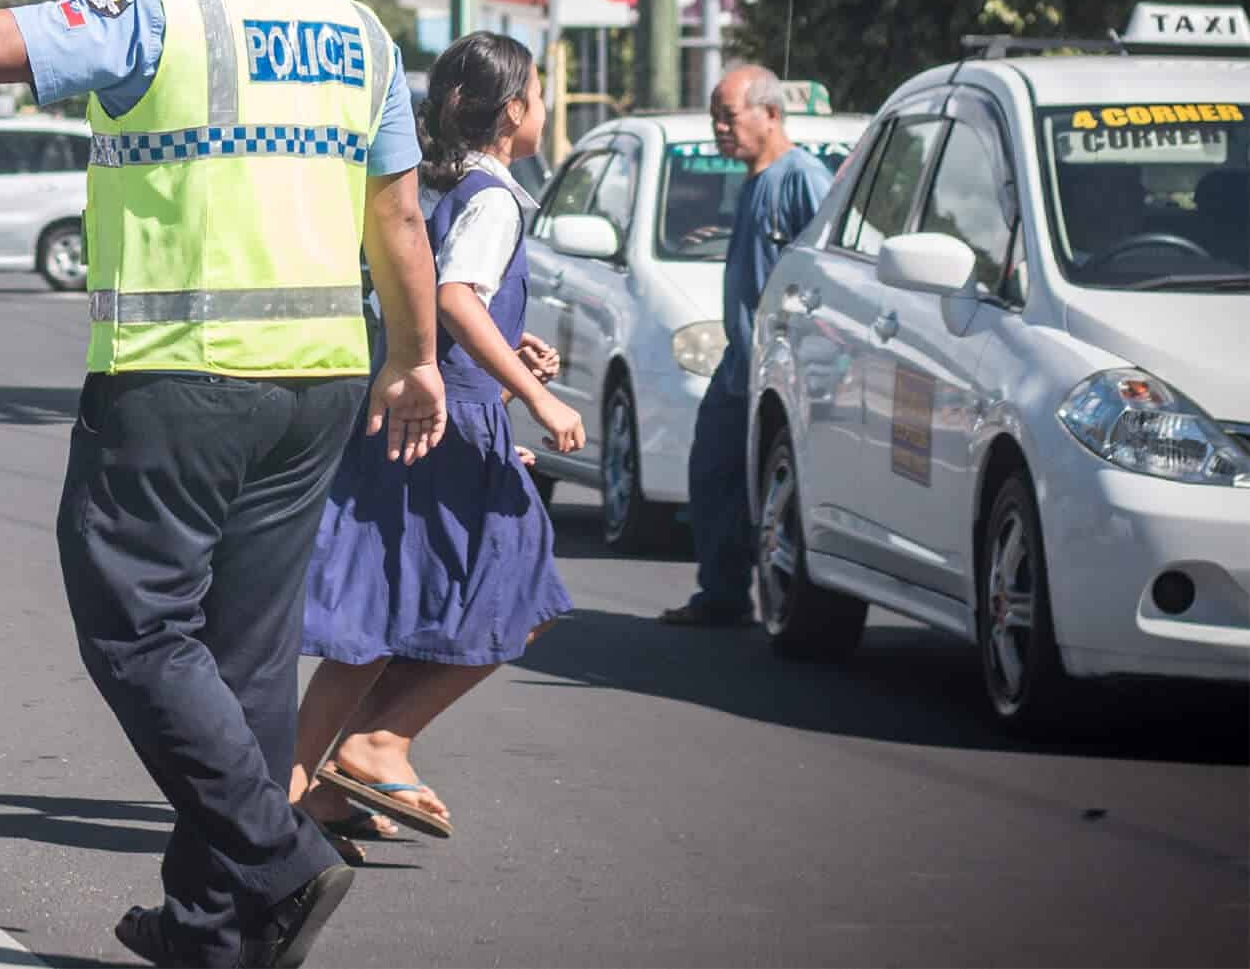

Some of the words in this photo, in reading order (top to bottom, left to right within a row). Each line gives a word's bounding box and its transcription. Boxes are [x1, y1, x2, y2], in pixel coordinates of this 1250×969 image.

[1150, 13, 1236, 34] TAXI
[245, 22, 364, 79] POLICE
[1072, 109, 1098, 129] 4
[1101, 103, 1244, 127] CORNER
